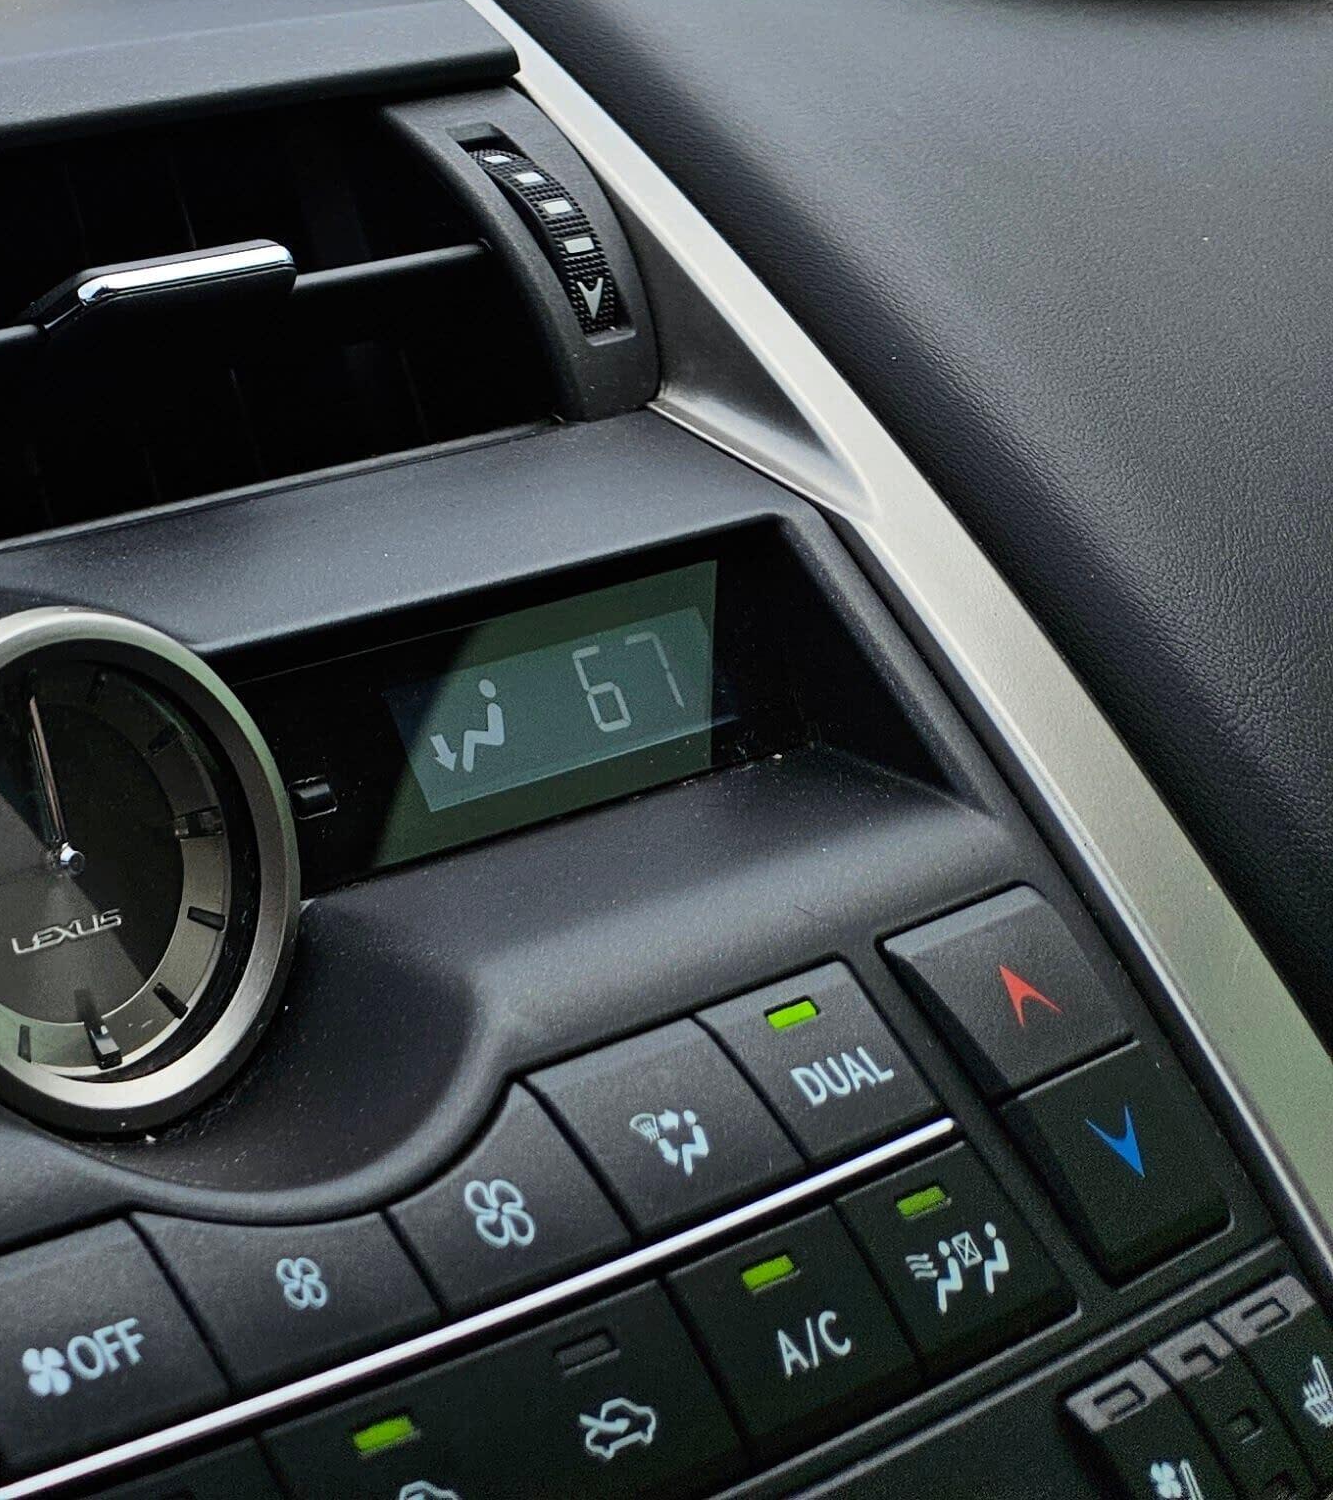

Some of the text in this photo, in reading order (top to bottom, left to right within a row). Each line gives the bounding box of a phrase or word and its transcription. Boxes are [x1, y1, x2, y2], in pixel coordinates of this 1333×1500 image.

[571, 631, 686, 733] 67
[10, 907, 123, 955] LEXUS
[790, 1046, 895, 1107] DUAL
[67, 1317, 146, 1380] OFF
[775, 1309, 853, 1380] A/C
